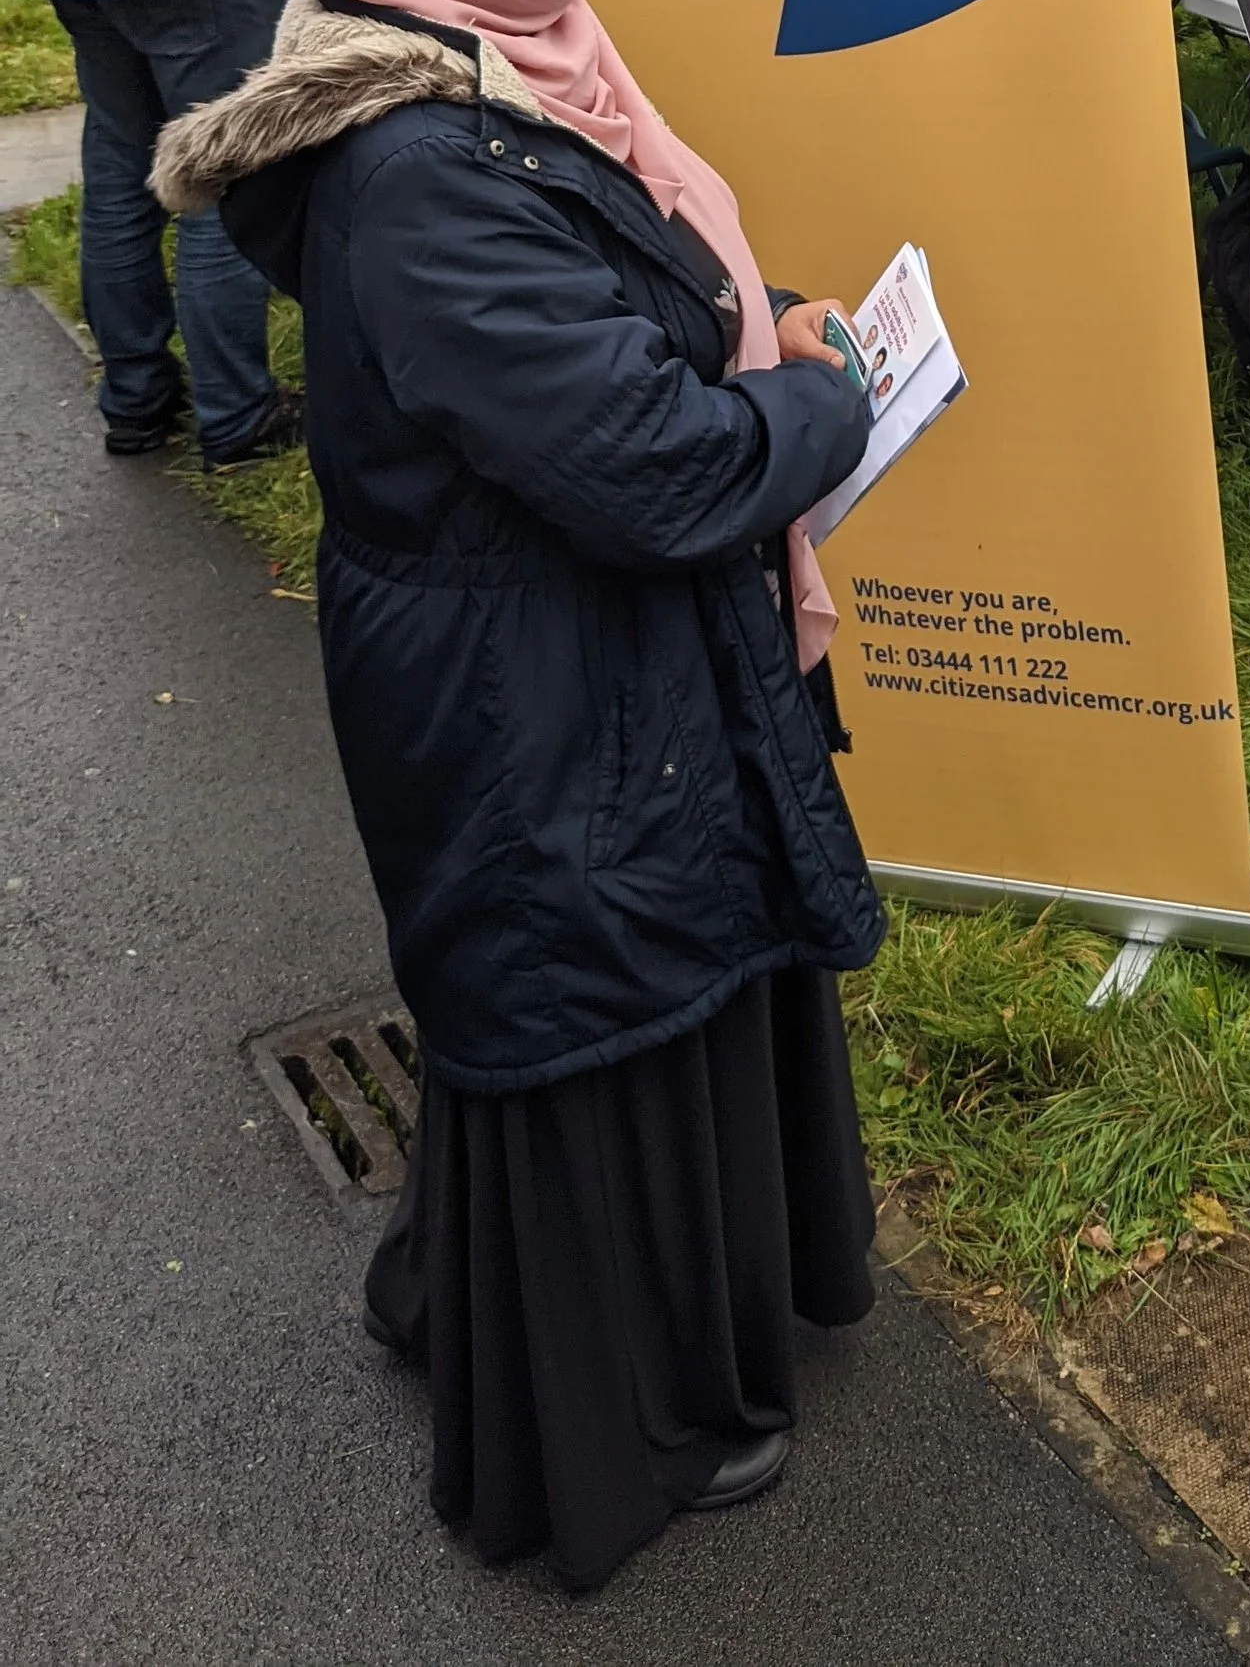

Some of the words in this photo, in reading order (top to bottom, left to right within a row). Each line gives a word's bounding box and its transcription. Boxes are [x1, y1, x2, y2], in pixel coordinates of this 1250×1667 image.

[851, 576, 954, 605] Whoever
[959, 591, 1005, 613] you
[1011, 594, 1058, 616] are,
[854, 602, 968, 633] Whatever
[973, 613, 1014, 637] the
[1020, 619, 1131, 646] problem.
[860, 642, 901, 666] Tel:
[906, 647, 974, 672] 03444
[979, 654, 1018, 677] 111
[1025, 657, 1069, 681] 222
[864, 671, 1235, 725] www.citizensadvicemcr.org.uk
